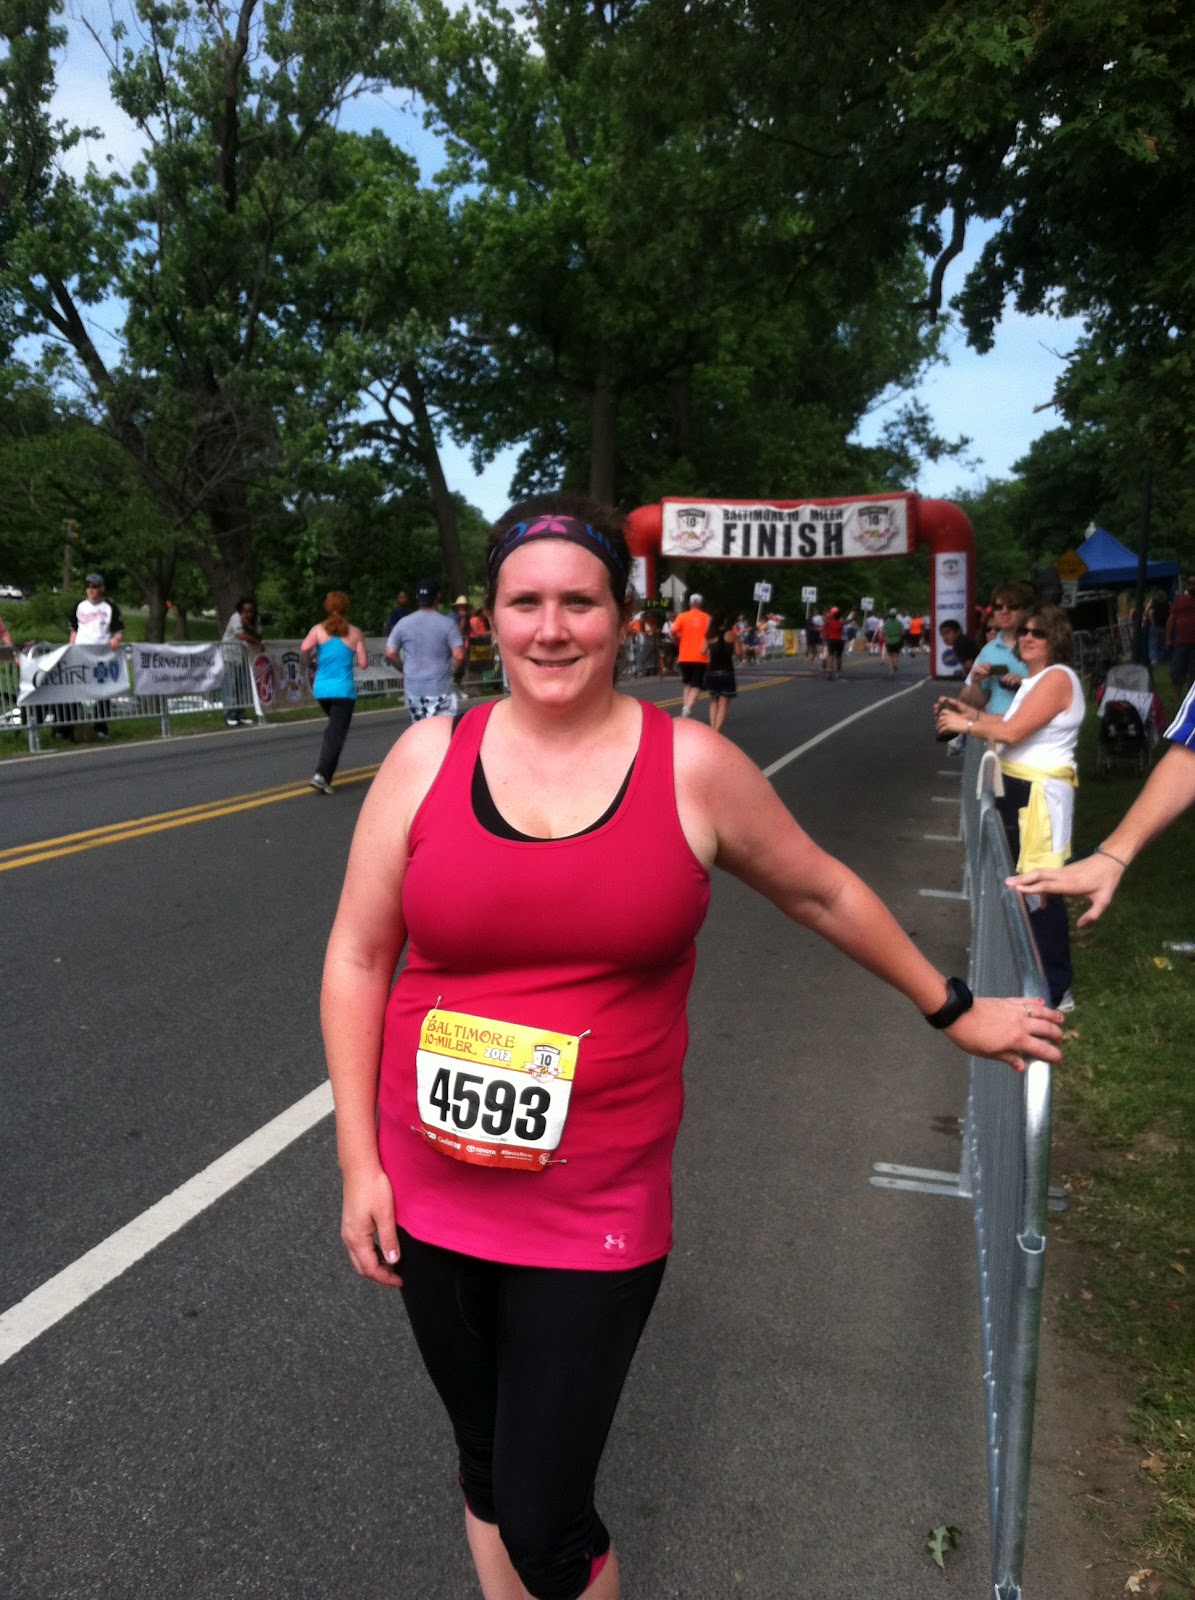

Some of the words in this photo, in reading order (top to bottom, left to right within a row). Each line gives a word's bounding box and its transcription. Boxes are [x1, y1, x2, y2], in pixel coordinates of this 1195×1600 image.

[723, 508, 785, 521] BALTIMORE
[722, 523, 843, 557] FINISH
[425, 1033, 477, 1055] 10-MILER
[483, 1046, 512, 1062] 2012
[427, 1018, 516, 1049] BALTIMORE
[540, 1053, 552, 1066] 10
[429, 1067, 551, 1141] 4593
